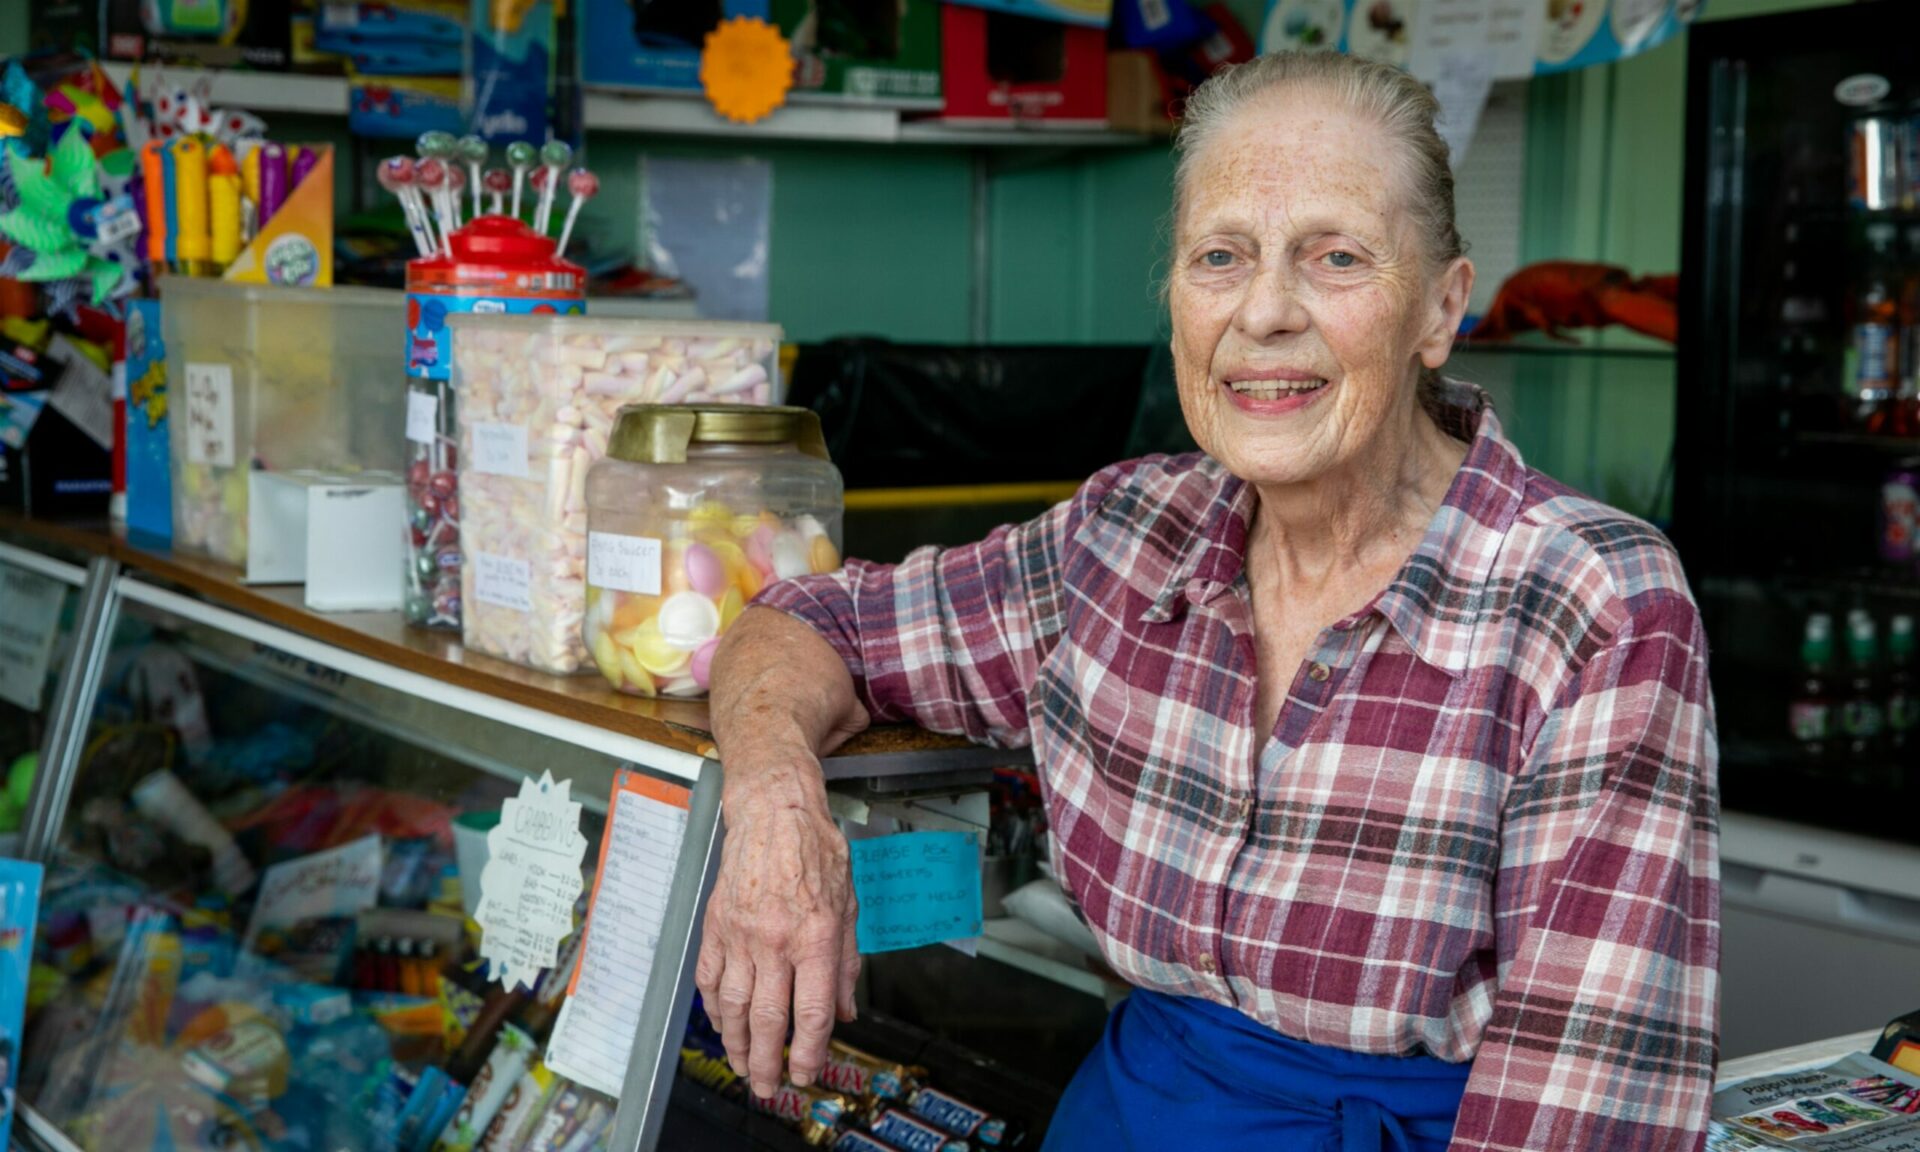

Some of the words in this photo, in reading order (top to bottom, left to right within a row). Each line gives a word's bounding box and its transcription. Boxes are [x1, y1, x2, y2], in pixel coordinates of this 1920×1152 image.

[514, 804, 579, 848] CRABBING
[853, 845, 911, 864] PLEASE
[863, 894, 885, 909] DO
[822, 1058, 868, 1096] WIX
